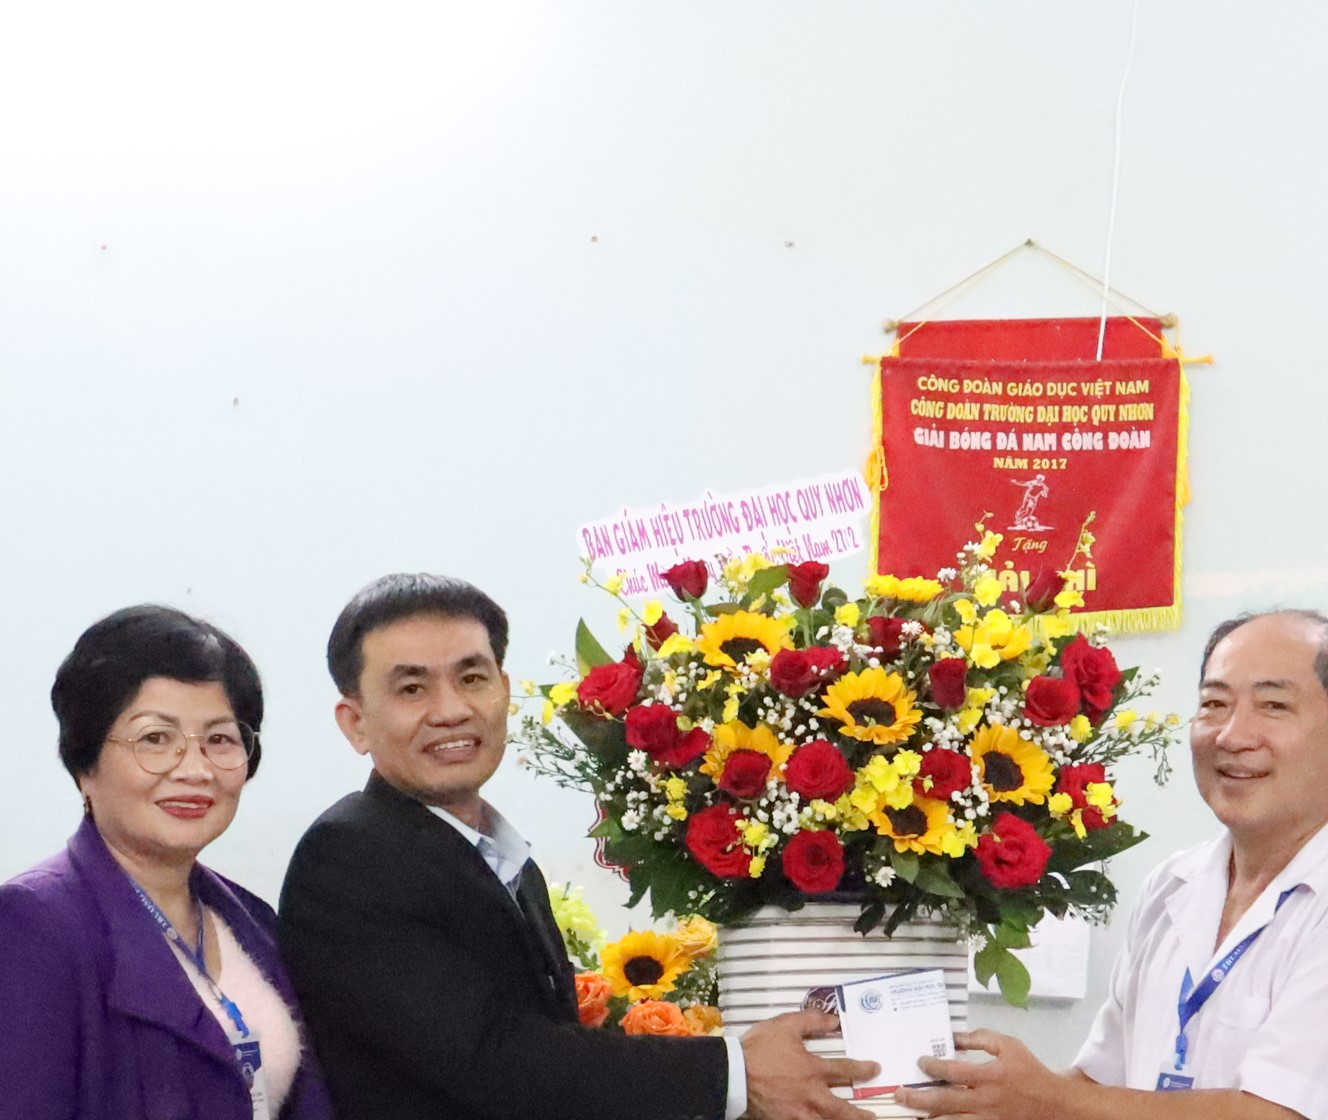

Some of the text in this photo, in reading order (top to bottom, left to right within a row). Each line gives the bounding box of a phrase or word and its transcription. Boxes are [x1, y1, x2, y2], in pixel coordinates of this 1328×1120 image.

[918, 374, 1150, 399] CÔNG ĐOÀN GIÁO DỤC VIỆT NAM
[911, 396, 944, 418] CÔNG
[1062, 405, 1088, 427] HỌC
[1091, 405, 1116, 426] QUY
[913, 423, 1151, 451] GIẢI BÓNG ĐÁ NAM CÔNG ĐOÀN
[993, 456, 1068, 470] NĂM 2017
[582, 524, 614, 560] BAN
[613, 508, 652, 555] GIÁM
[650, 502, 684, 557] HIỆU
[683, 491, 741, 541] TRƯỜNG
[796, 484, 824, 522] QUY
[824, 477, 864, 515] NHƠN
[1012, 537, 1048, 554] Tặng
